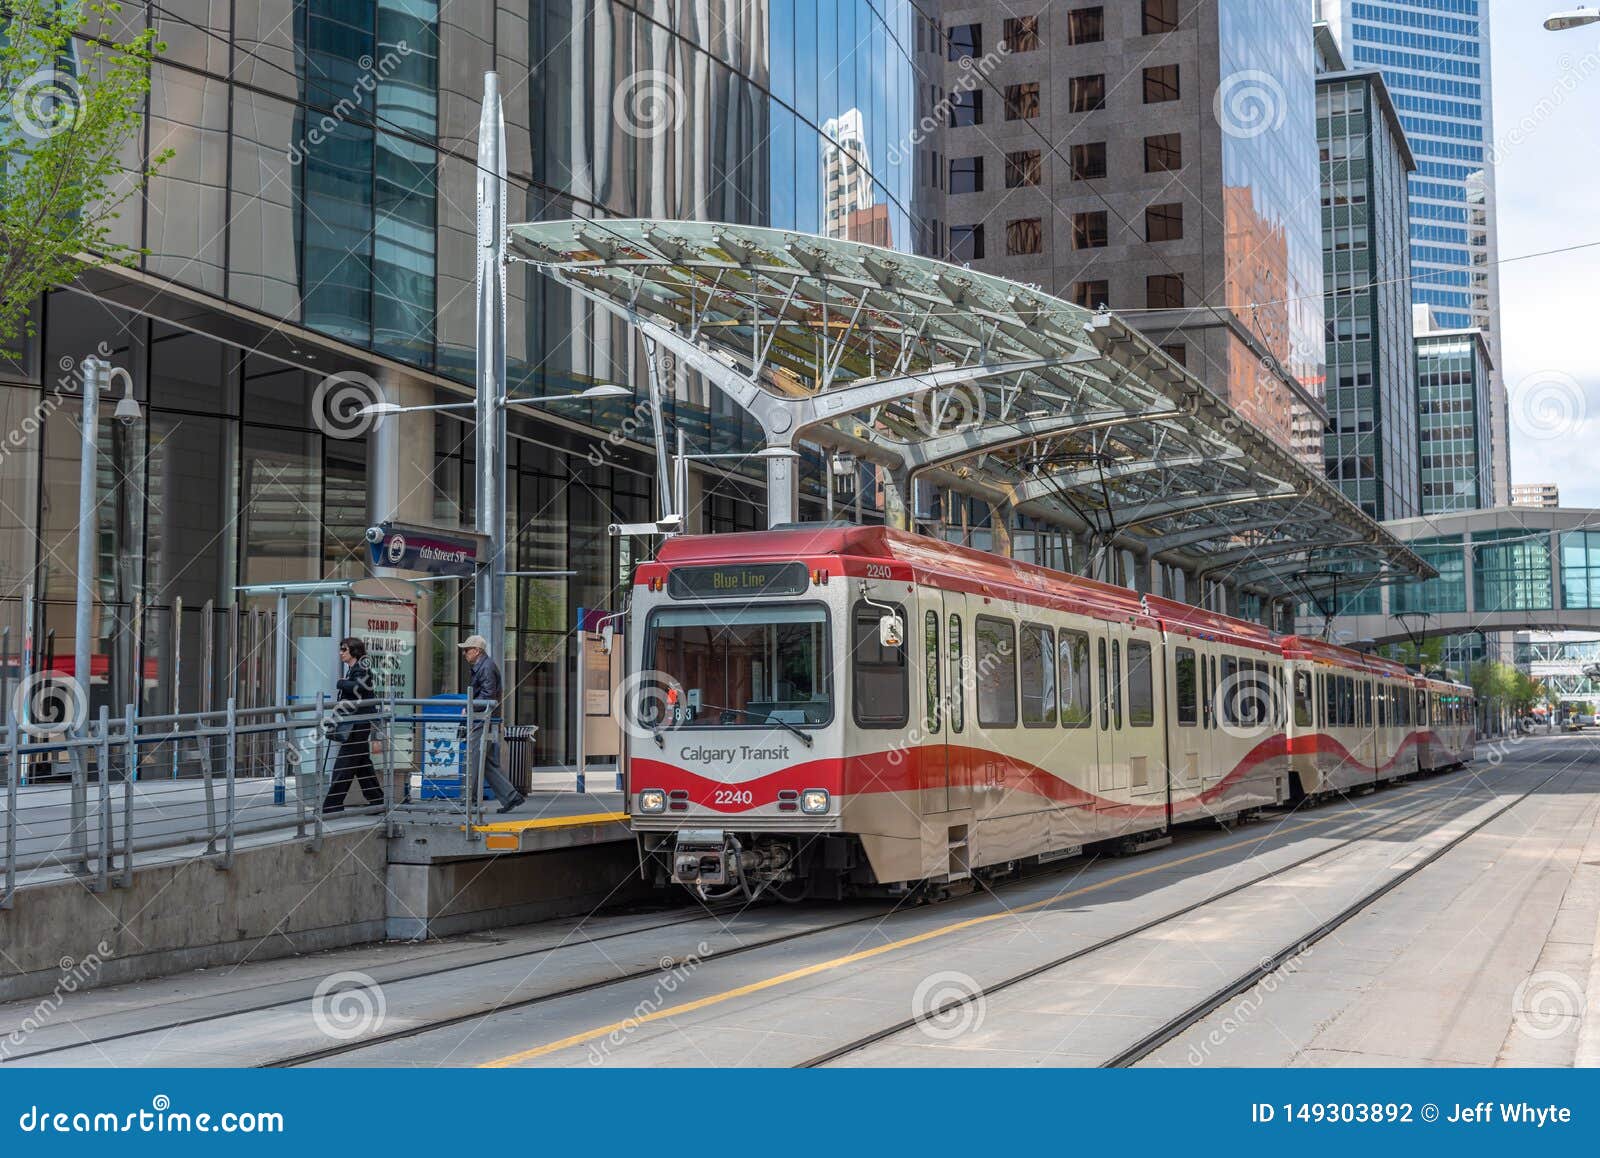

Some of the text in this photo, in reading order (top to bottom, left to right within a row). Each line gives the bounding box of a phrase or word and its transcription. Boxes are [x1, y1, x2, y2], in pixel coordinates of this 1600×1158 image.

[419, 544, 433, 559] 6th
[433, 547, 454, 562] Street
[866, 564, 891, 579] 2240
[713, 571, 766, 589] Blue Line
[367, 619, 399, 634] STAND UP
[680, 745, 789, 764] Calgary Transit
[715, 790, 753, 804] 2240
